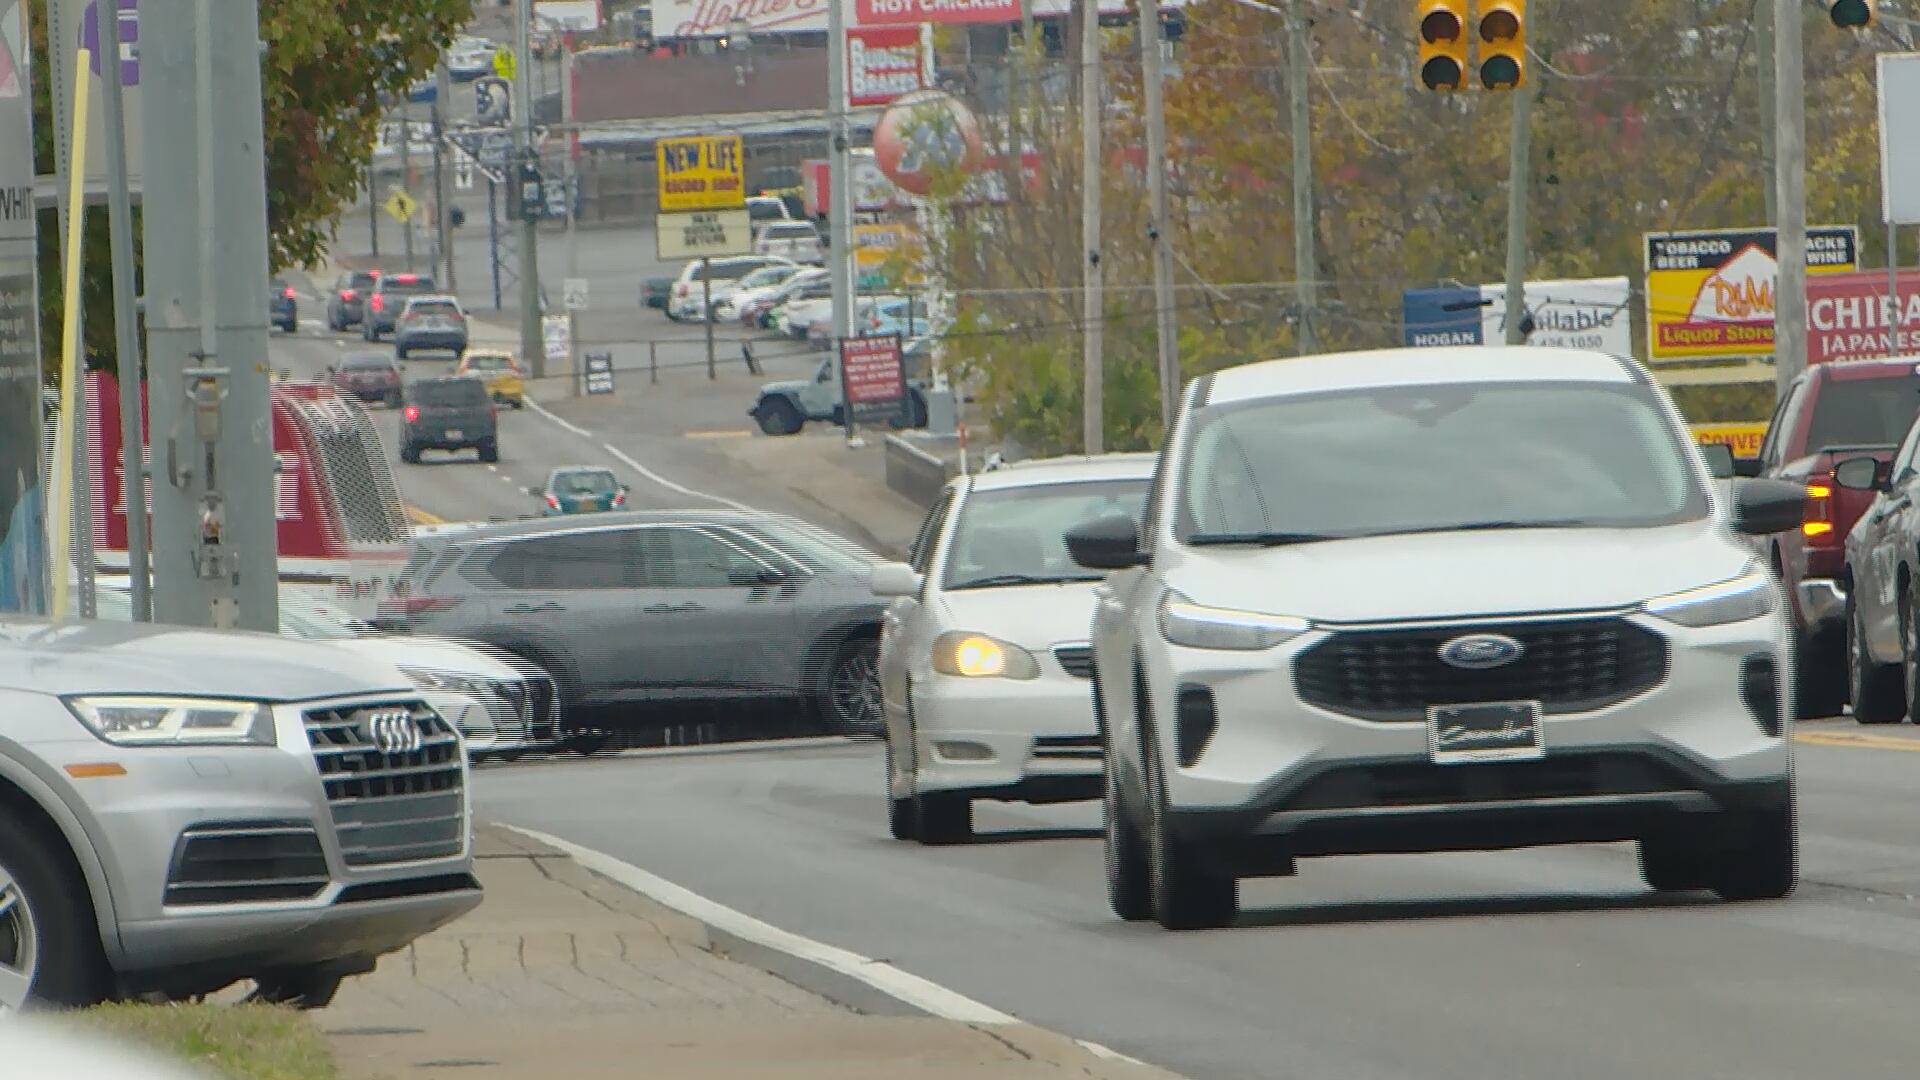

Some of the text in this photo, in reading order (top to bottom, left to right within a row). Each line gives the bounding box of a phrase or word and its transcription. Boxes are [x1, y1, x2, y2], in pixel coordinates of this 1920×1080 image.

[852, 69, 919, 97] BRAKES
[663, 140, 738, 174] NEW LIFE
[665, 179, 705, 194] RECORD
[1656, 236, 1846, 257] TOBACCO ACKS
[1656, 251, 1848, 268] BEER WINE
[1415, 332, 1475, 347] HOGAN
[1663, 326, 1720, 344] Liquor
